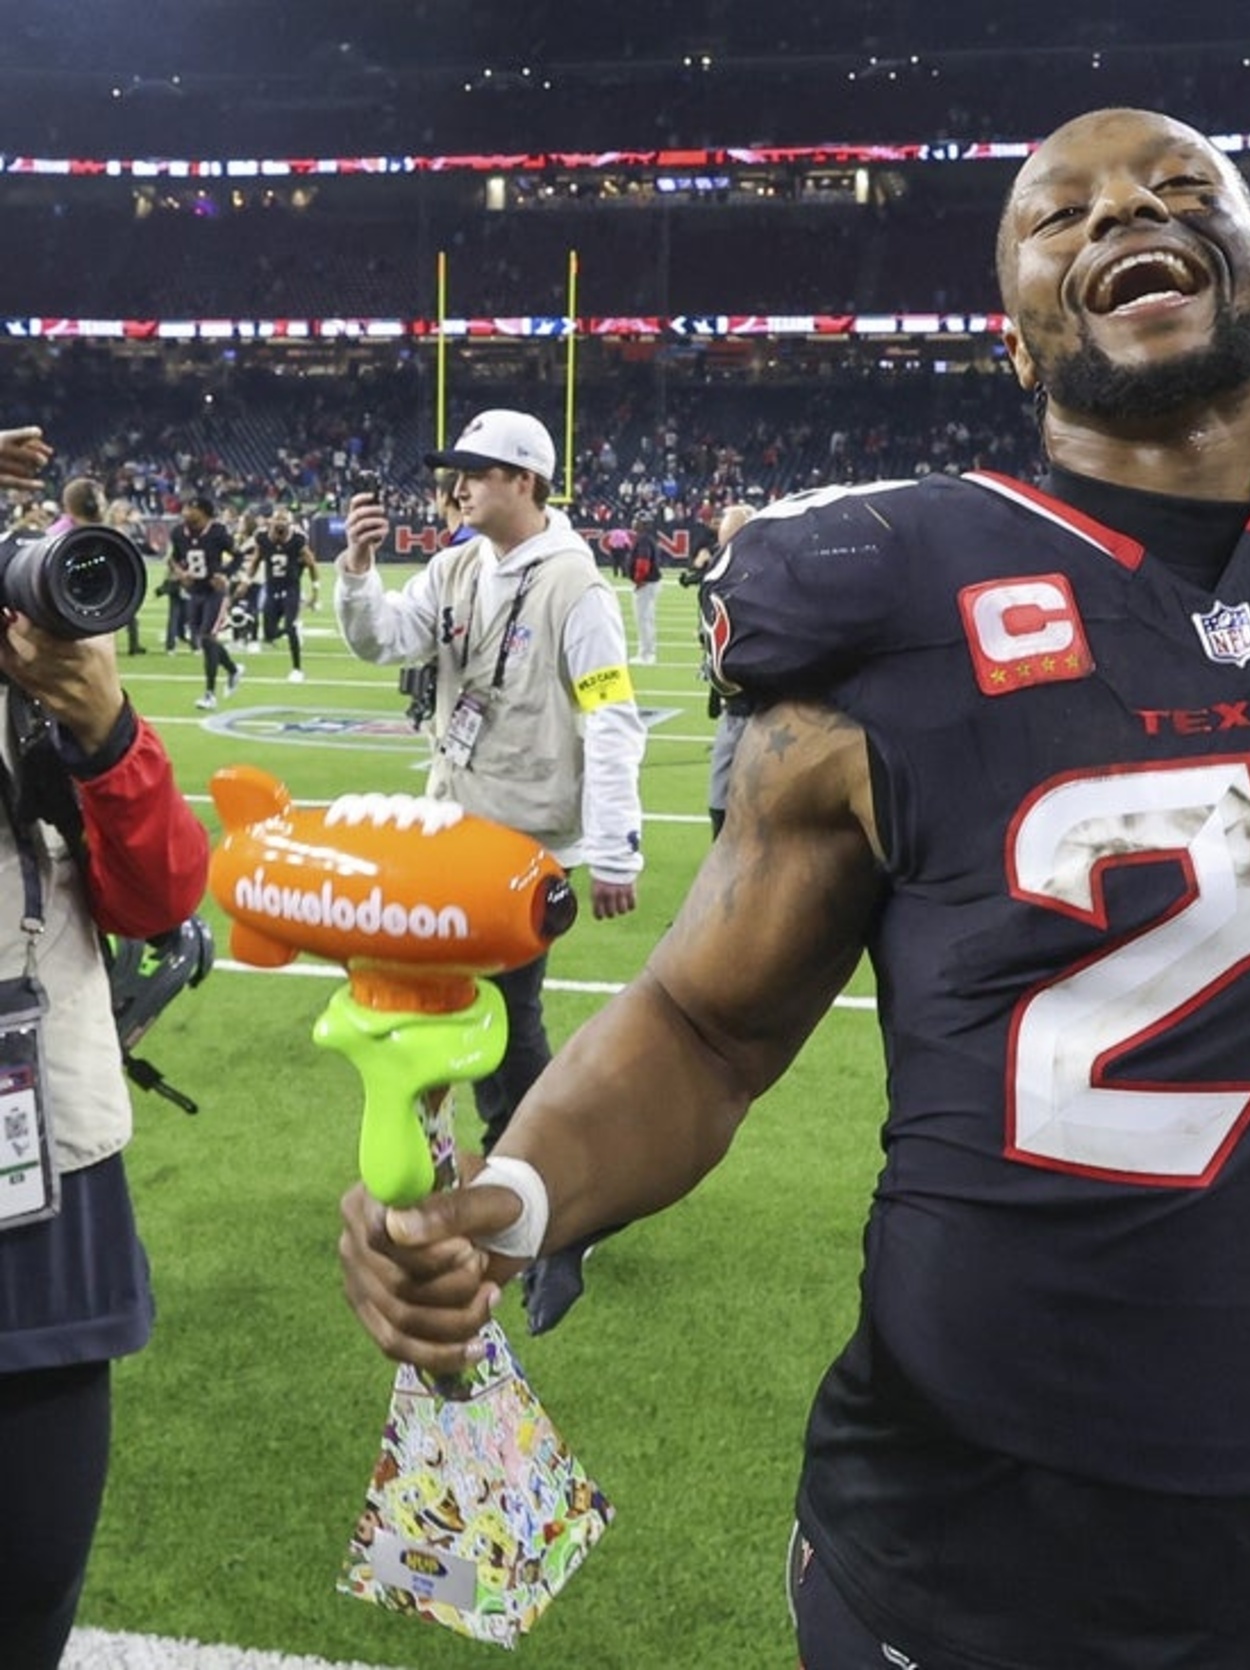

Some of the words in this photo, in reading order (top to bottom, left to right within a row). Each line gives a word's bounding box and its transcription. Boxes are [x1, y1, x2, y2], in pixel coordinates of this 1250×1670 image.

[186, 549, 208, 580] 8
[270, 553, 288, 578] 2
[972, 581, 1074, 663] C
[235, 866, 469, 939] nickelodeon
